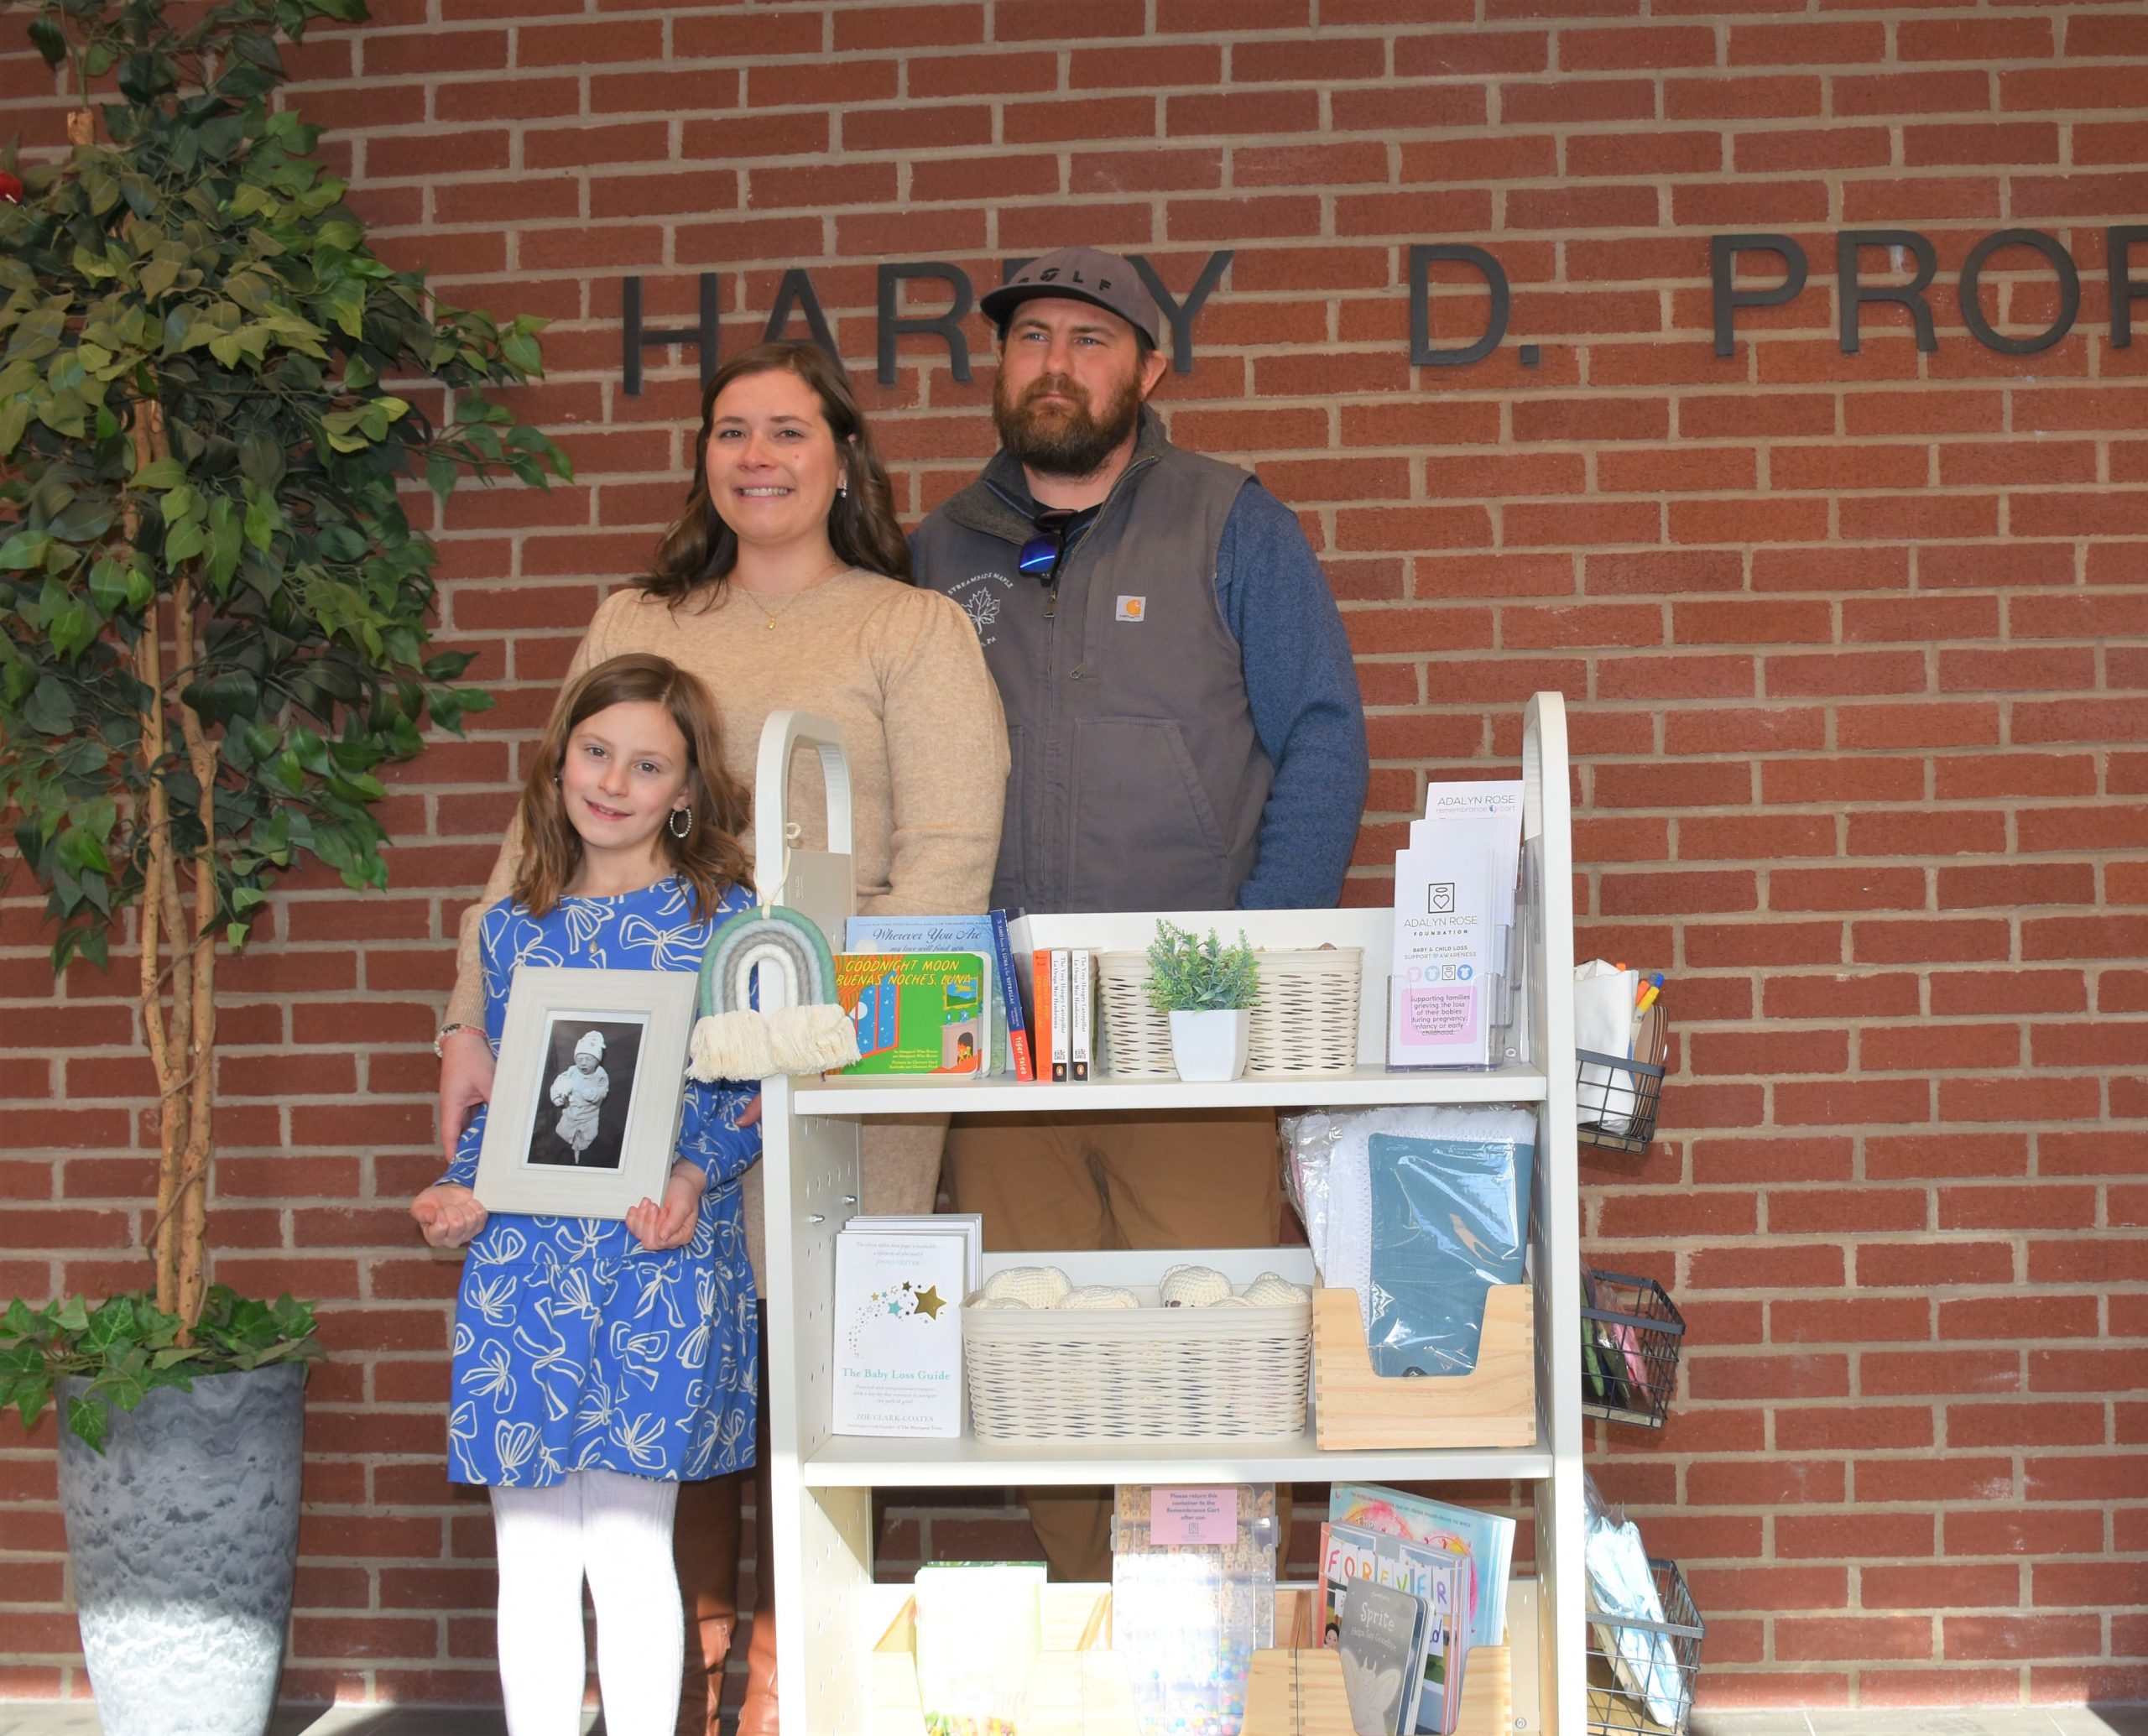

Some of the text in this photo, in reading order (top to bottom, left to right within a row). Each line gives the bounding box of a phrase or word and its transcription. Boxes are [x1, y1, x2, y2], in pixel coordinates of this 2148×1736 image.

[623, 249, 1234, 397] HARY
[1410, 244, 1540, 366] D.
[993, 572, 1014, 588] MAPLE
[1437, 795, 1515, 805] ADALYN ROSE
[1436, 805, 1488, 814] remembrance
[1404, 915, 1478, 928] ADALYN ROSE
[873, 927, 982, 943] Wherever You Are
[846, 959, 959, 972] GOODNIGHT MOON
[836, 974, 882, 986] BUENAS
[941, 974, 971, 985] LUNA
[842, 1368, 951, 1381] The Baby Loss Guide
[1360, 1602, 1395, 1632] Sprite
